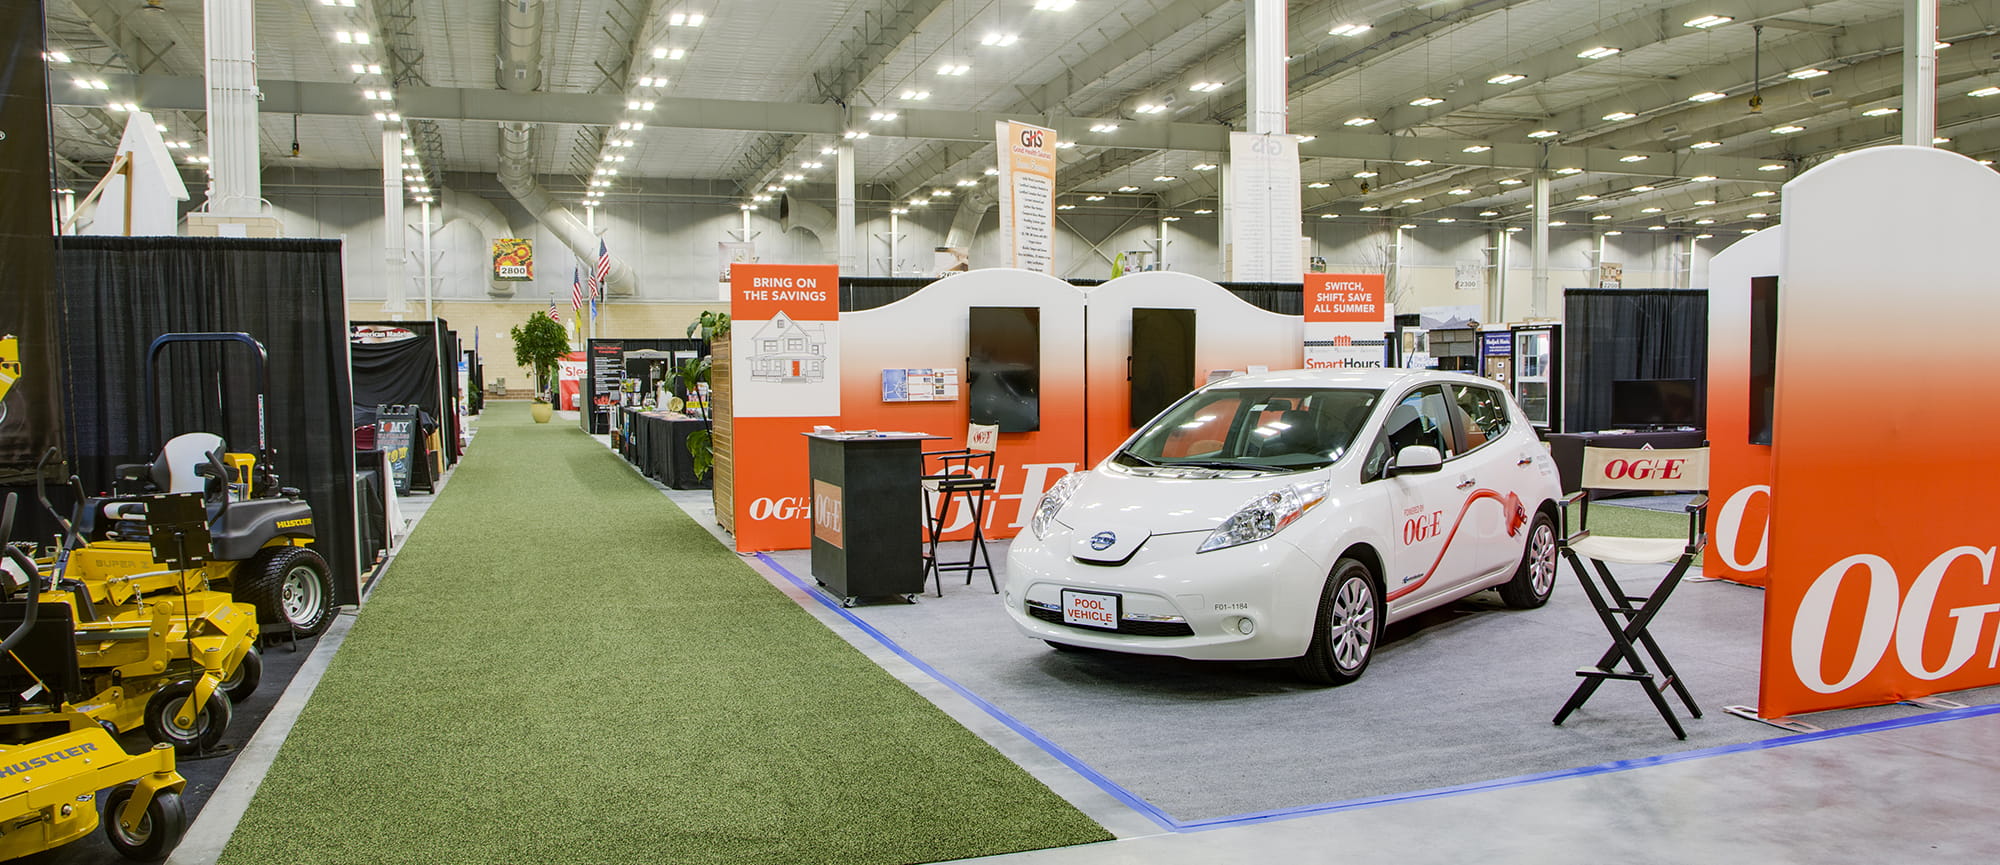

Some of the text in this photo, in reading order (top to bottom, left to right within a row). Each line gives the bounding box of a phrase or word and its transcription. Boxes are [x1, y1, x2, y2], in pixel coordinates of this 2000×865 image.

[1021, 130, 1043, 148] GHS
[501, 267, 526, 275] 2800
[753, 277, 817, 289] BRING ON
[1325, 281, 1364, 292] SWITCH,
[1460, 280, 1476, 288] 2300
[743, 290, 827, 302] THE SAVINGS
[1316, 293, 1373, 303] SHIFT, SAVE
[1313, 304, 1376, 313] ALL SUMMER
[1305, 358, 1381, 369] SmartHours
[276, 517, 312, 529] HUSTLER
[95, 559, 136, 568] SUPER
[1074, 598, 1105, 611] POOL
[1214, 603, 1248, 611] F01-1184
[1067, 608, 1113, 623] VEHICLE
[0, 742, 98, 778] HUSTLER
